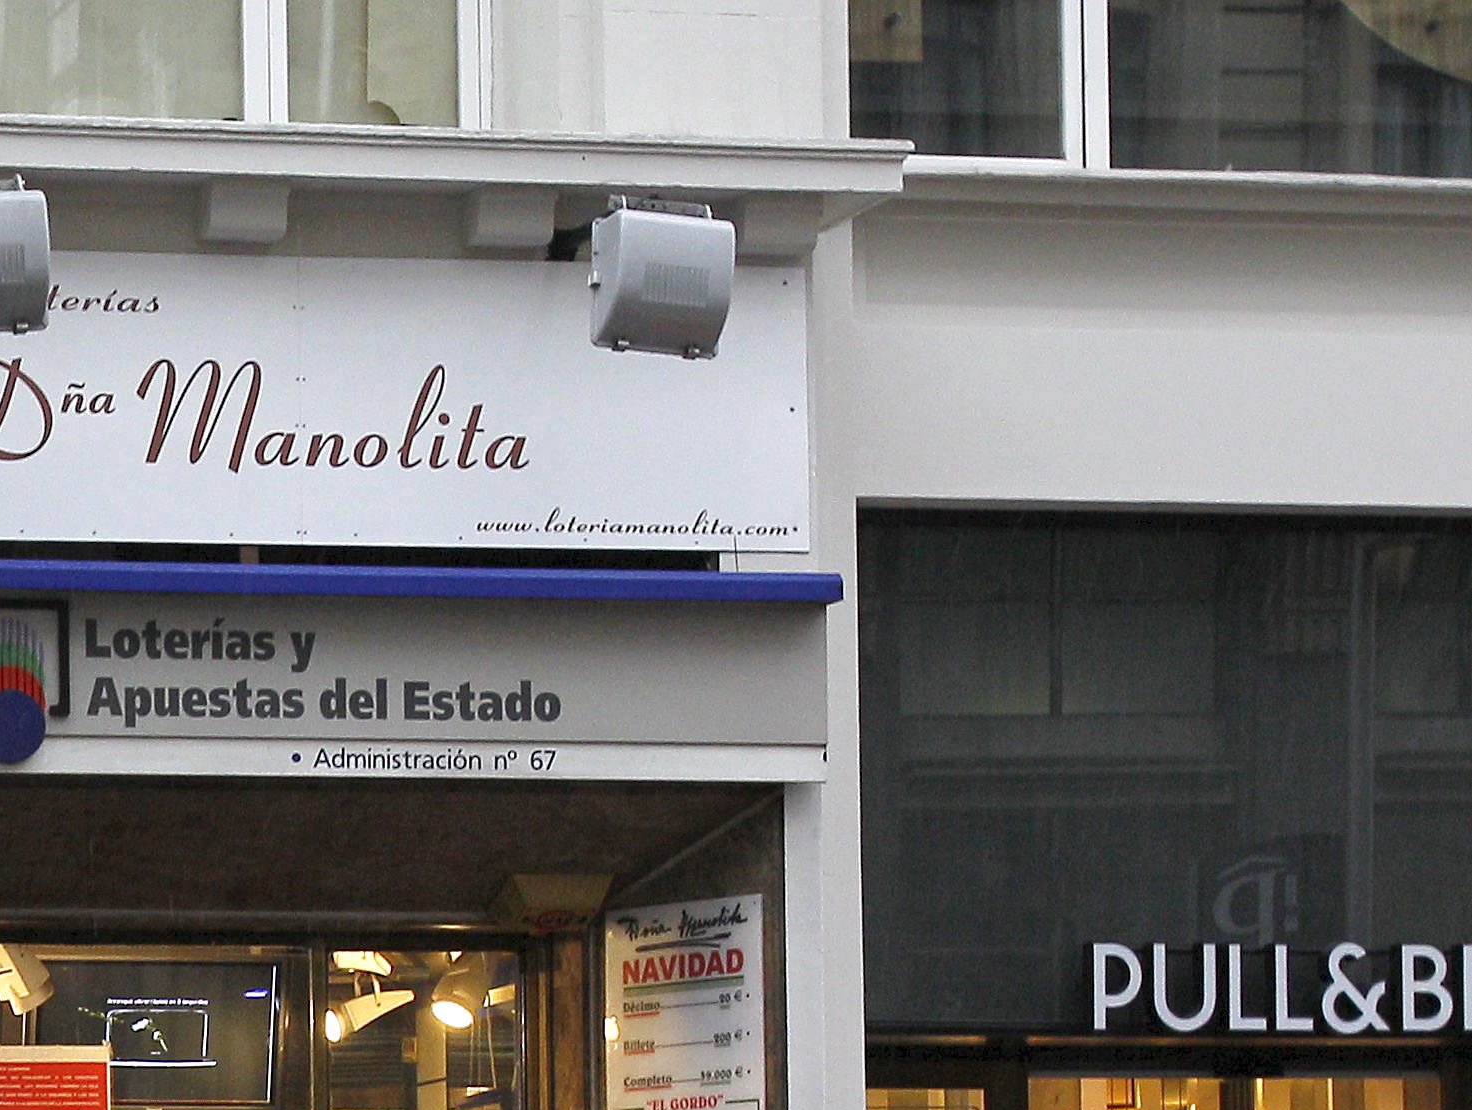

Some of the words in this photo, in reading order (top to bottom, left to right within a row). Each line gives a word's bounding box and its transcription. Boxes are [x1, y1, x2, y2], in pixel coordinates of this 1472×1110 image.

[48, 284, 161, 313] terías
[137, 358, 530, 474] Manolita
[475, 506, 790, 537] www.loteriamanolita.com
[84, 618, 276, 661] Loterías
[291, 631, 316, 673] y
[87, 677, 305, 727] Apuestas
[319, 678, 388, 721] del
[404, 680, 562, 723] Estado
[312, 747, 482, 771] Administración
[530, 750, 557, 771] 67
[622, 947, 745, 985] NAVIDAD
[624, 1075, 673, 1088] Completo
